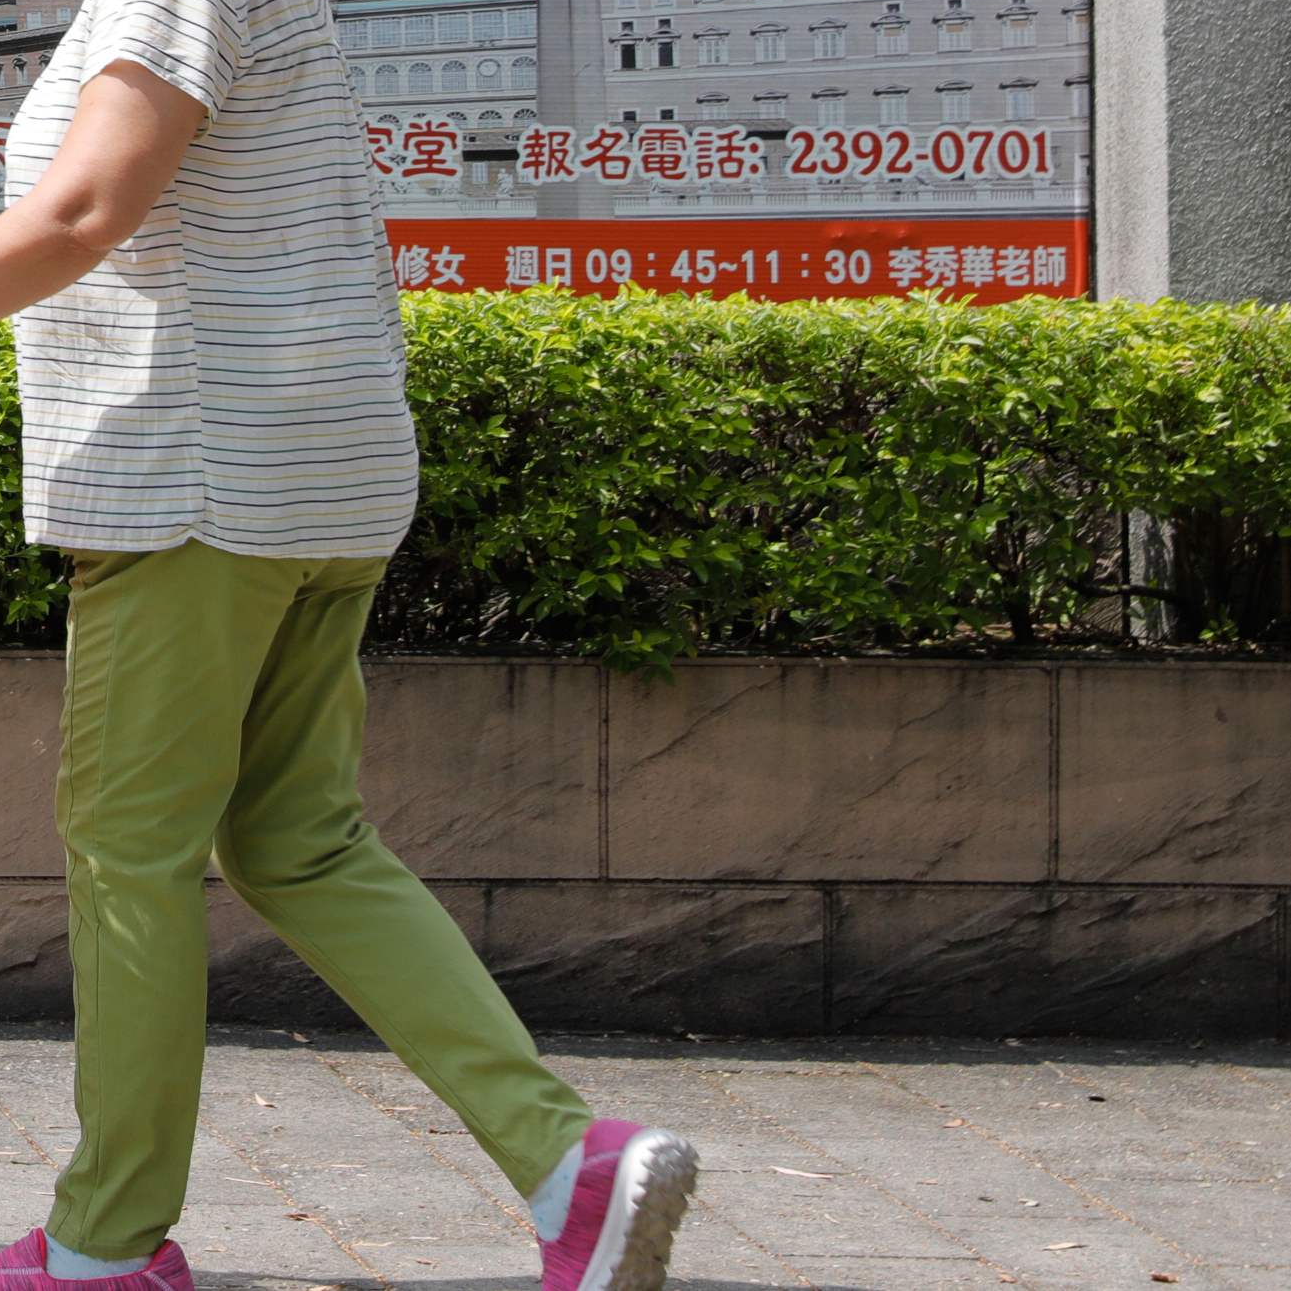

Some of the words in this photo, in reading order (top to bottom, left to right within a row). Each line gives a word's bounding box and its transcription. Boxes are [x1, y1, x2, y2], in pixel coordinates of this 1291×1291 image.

[521, 127, 761, 181] 報名電話:
[789, 128, 1051, 177] 2392-0701
[504, 245, 572, 287] 週日
[887, 244, 1067, 288] 李秀華老師
